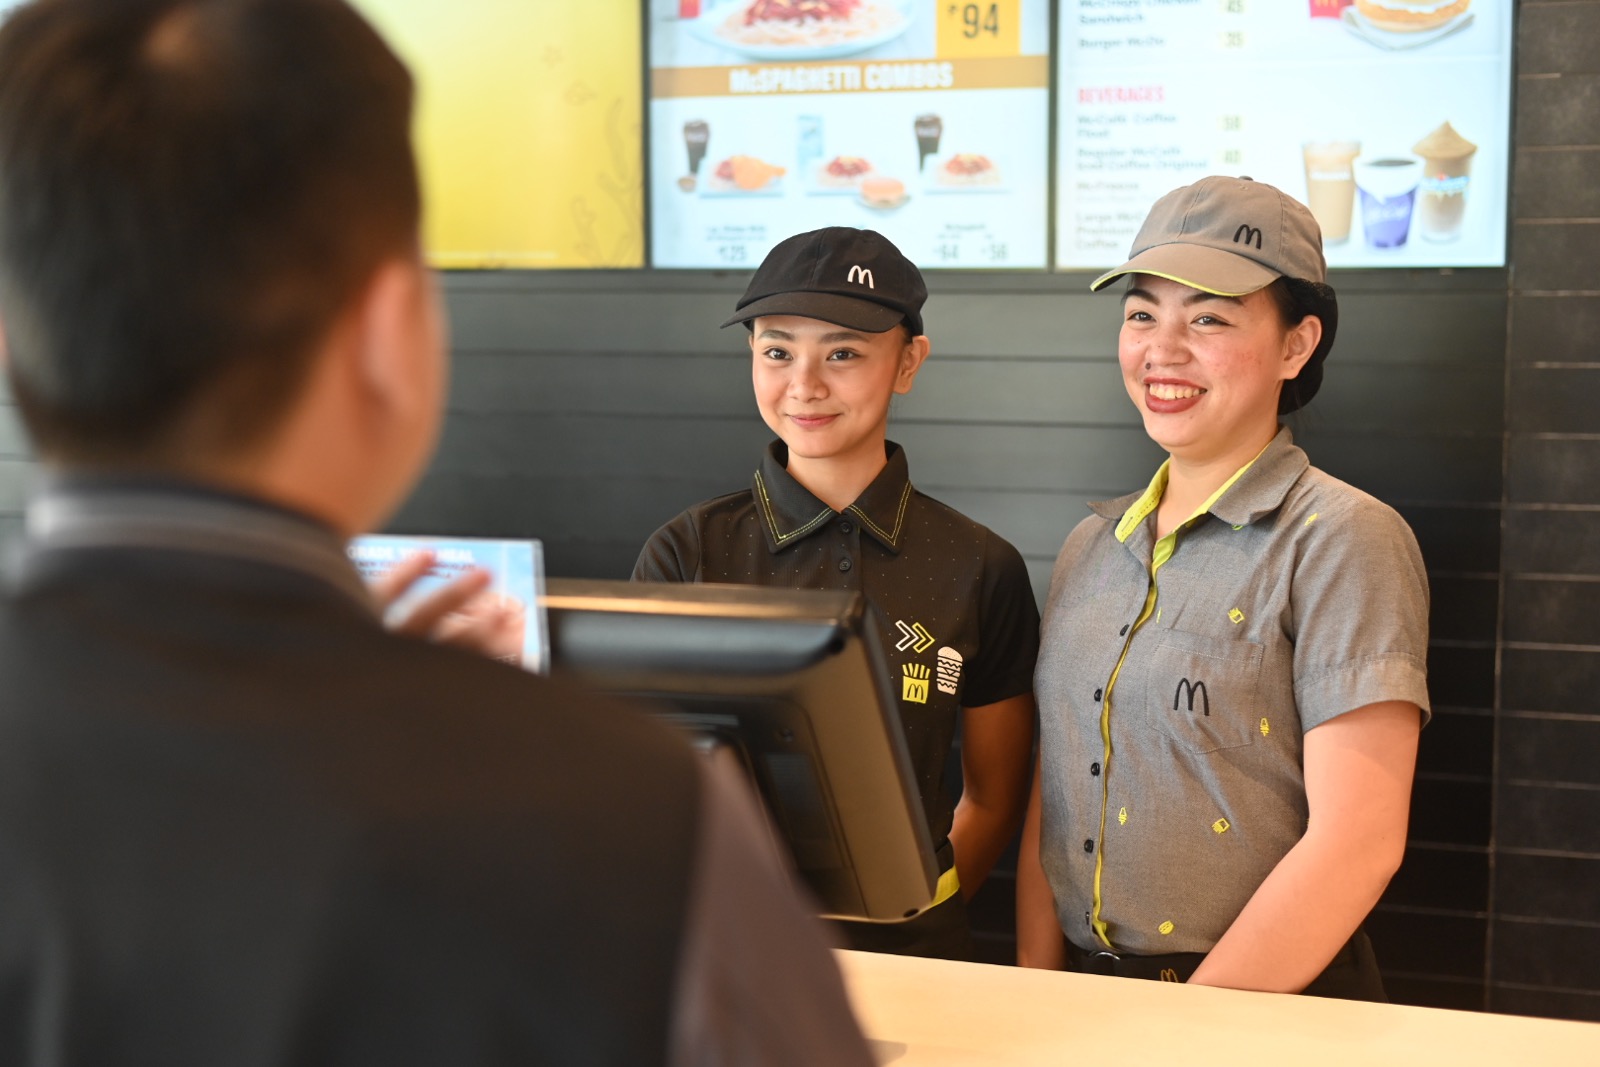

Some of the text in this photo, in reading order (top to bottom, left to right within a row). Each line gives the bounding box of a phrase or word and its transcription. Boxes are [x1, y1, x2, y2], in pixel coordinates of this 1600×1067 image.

[1079, 14, 1145, 25] Sandwich
[1078, 38, 1122, 51] Burger
[865, 62, 954, 89] COMBOS
[1077, 85, 1164, 105] BEVERAGES
[1132, 113, 1177, 124] Coffee
